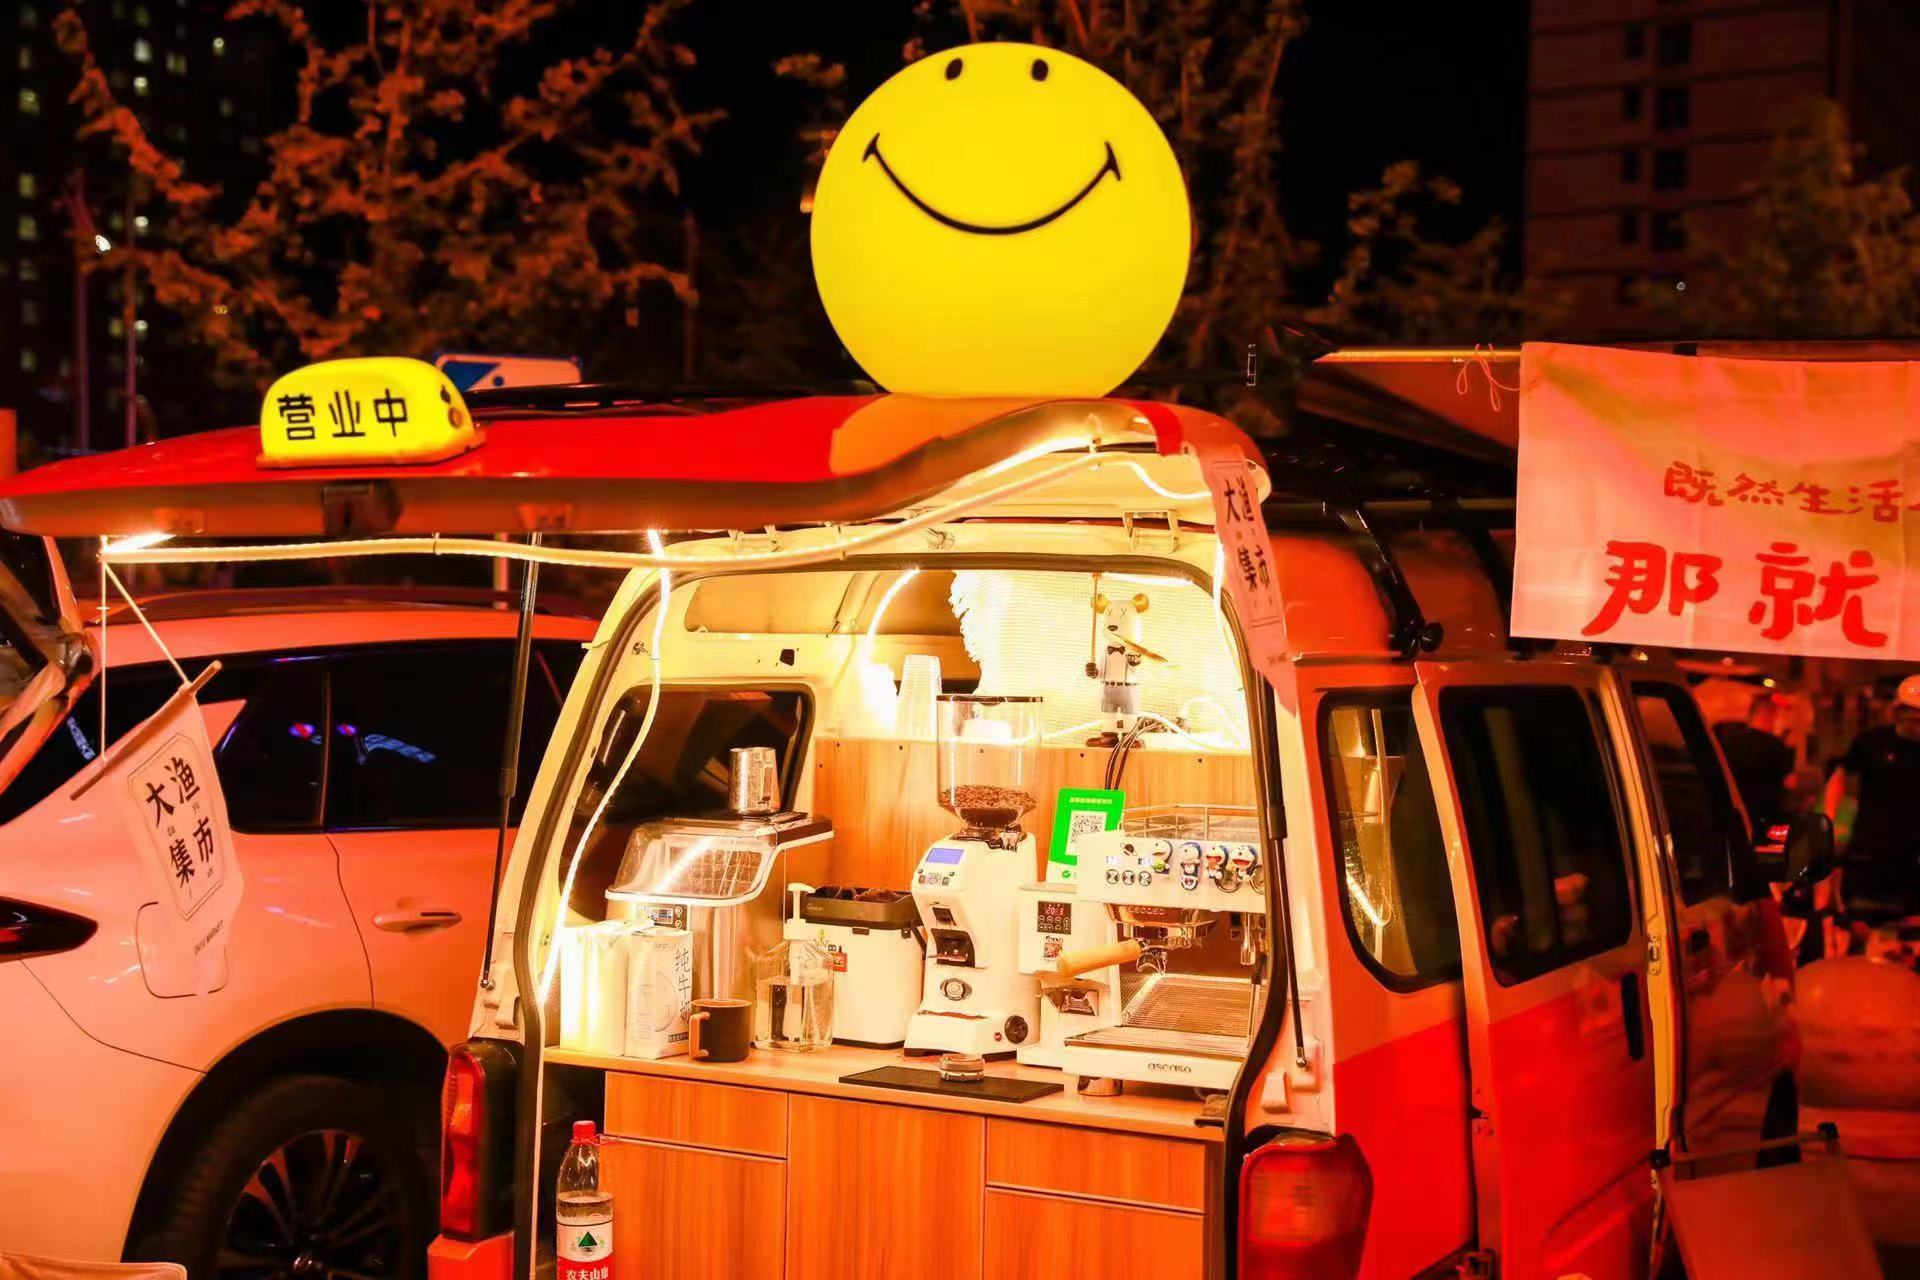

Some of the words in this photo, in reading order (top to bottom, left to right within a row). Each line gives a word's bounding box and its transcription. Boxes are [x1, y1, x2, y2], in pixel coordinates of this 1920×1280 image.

[276, 387, 409, 440] 营业中
[1663, 461, 1920, 523] 既然生活
[1581, 540, 1888, 647] 那就
